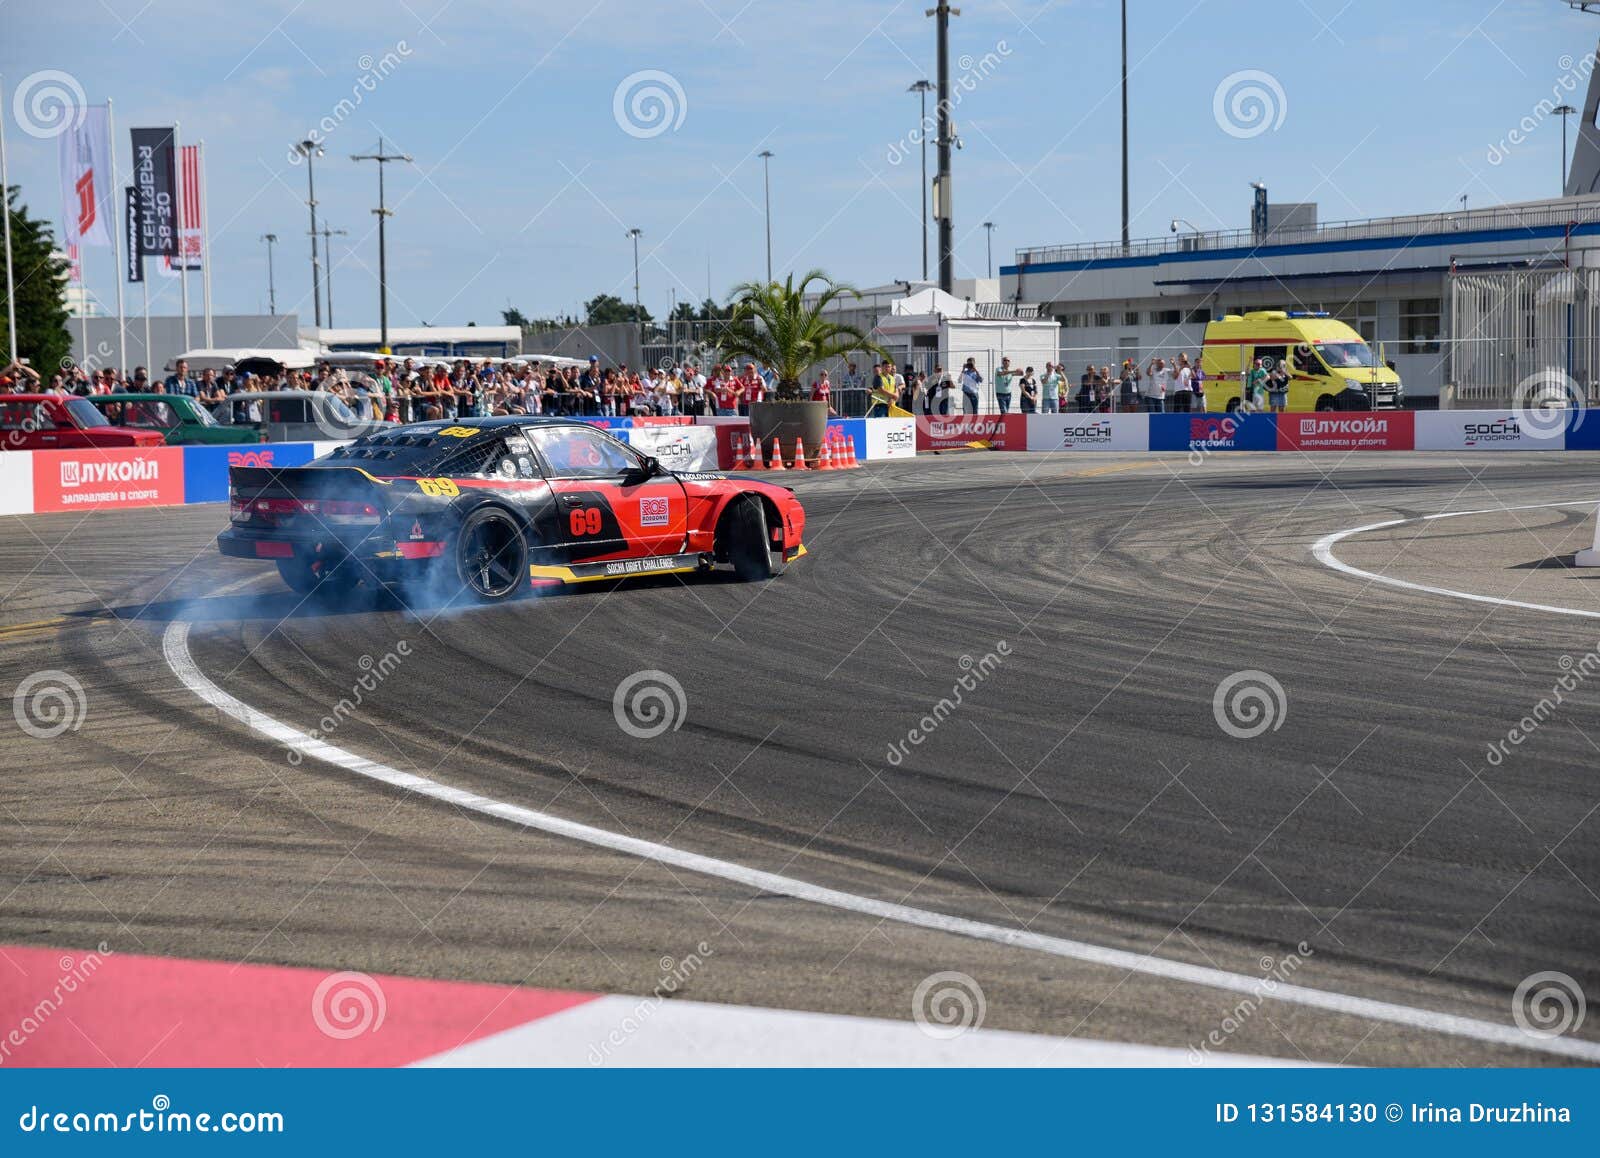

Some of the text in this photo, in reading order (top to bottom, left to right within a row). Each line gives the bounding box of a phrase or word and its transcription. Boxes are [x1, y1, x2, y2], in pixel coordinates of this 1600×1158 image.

[945, 419, 1006, 435] ЛУКОЙЛ
[1064, 427, 1111, 437] SOCHI
[1317, 417, 1387, 433] ЛУКОЙЛ
[1464, 424, 1520, 434] SOCHI
[886, 432, 912, 442] SOCHI
[81, 457, 158, 483] ЛУКОЙЛ
[416, 477, 460, 497] 69
[62, 490, 158, 504] ЗАПРАВЛЯЕМ В СПОРТЕ
[570, 508, 603, 536] 69
[606, 557, 674, 574] SOCHI DRIFT CHALLENGE
